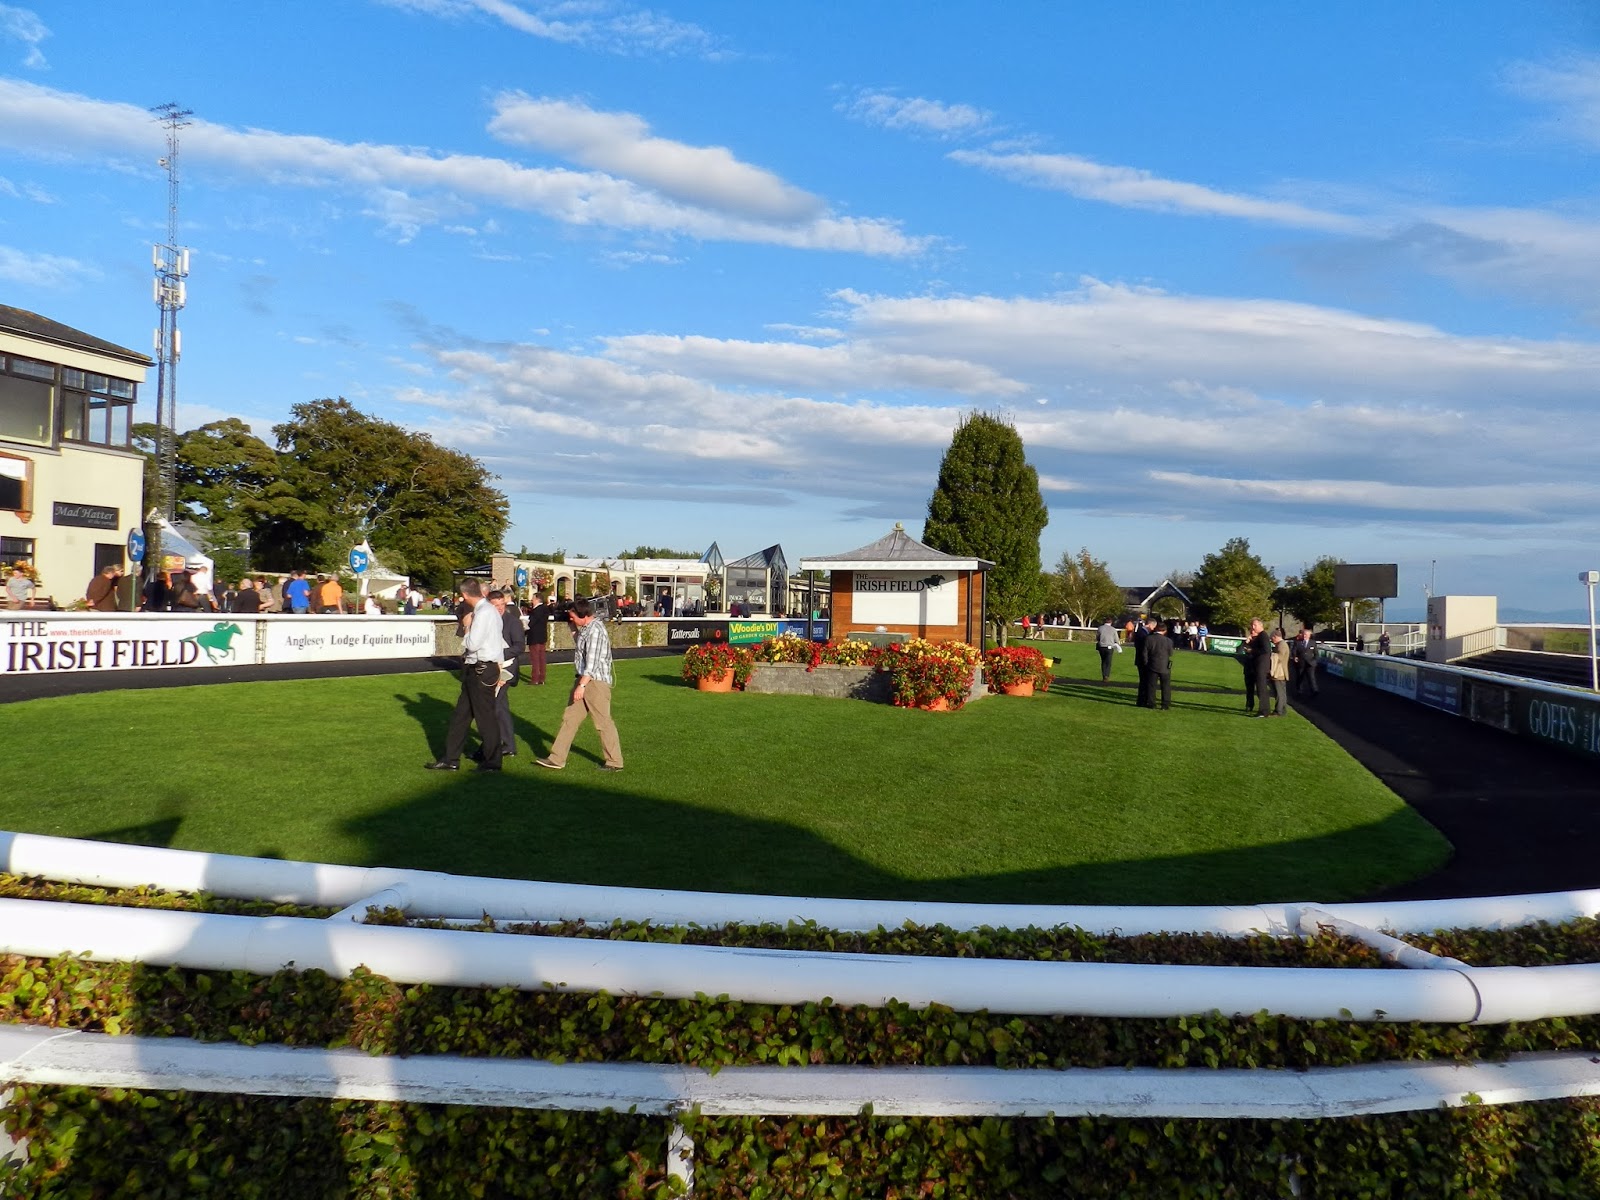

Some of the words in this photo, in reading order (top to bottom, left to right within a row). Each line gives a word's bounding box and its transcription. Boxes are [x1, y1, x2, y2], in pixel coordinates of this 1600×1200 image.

[55, 505, 81, 517] Mad
[81, 508, 115, 520] Hatter
[855, 580, 887, 591] IRISH
[890, 580, 925, 592] FIELD
[7, 621, 48, 637] THE
[49, 628, 122, 636] www.theirishfield.ie
[671, 628, 700, 640] Tattersalls
[730, 623, 765, 634] Woodie's
[766, 623, 777, 632] DIY
[285, 634, 325, 650] Anglesey
[330, 634, 360, 648] Lodge
[362, 634, 394, 647] Equine
[395, 633, 430, 648] Hospital
[1214, 638, 1237, 648] Paddy
[6, 640, 104, 671] IRISH
[111, 639, 199, 667] FIELD
[1529, 699, 1576, 745] GOFFS
